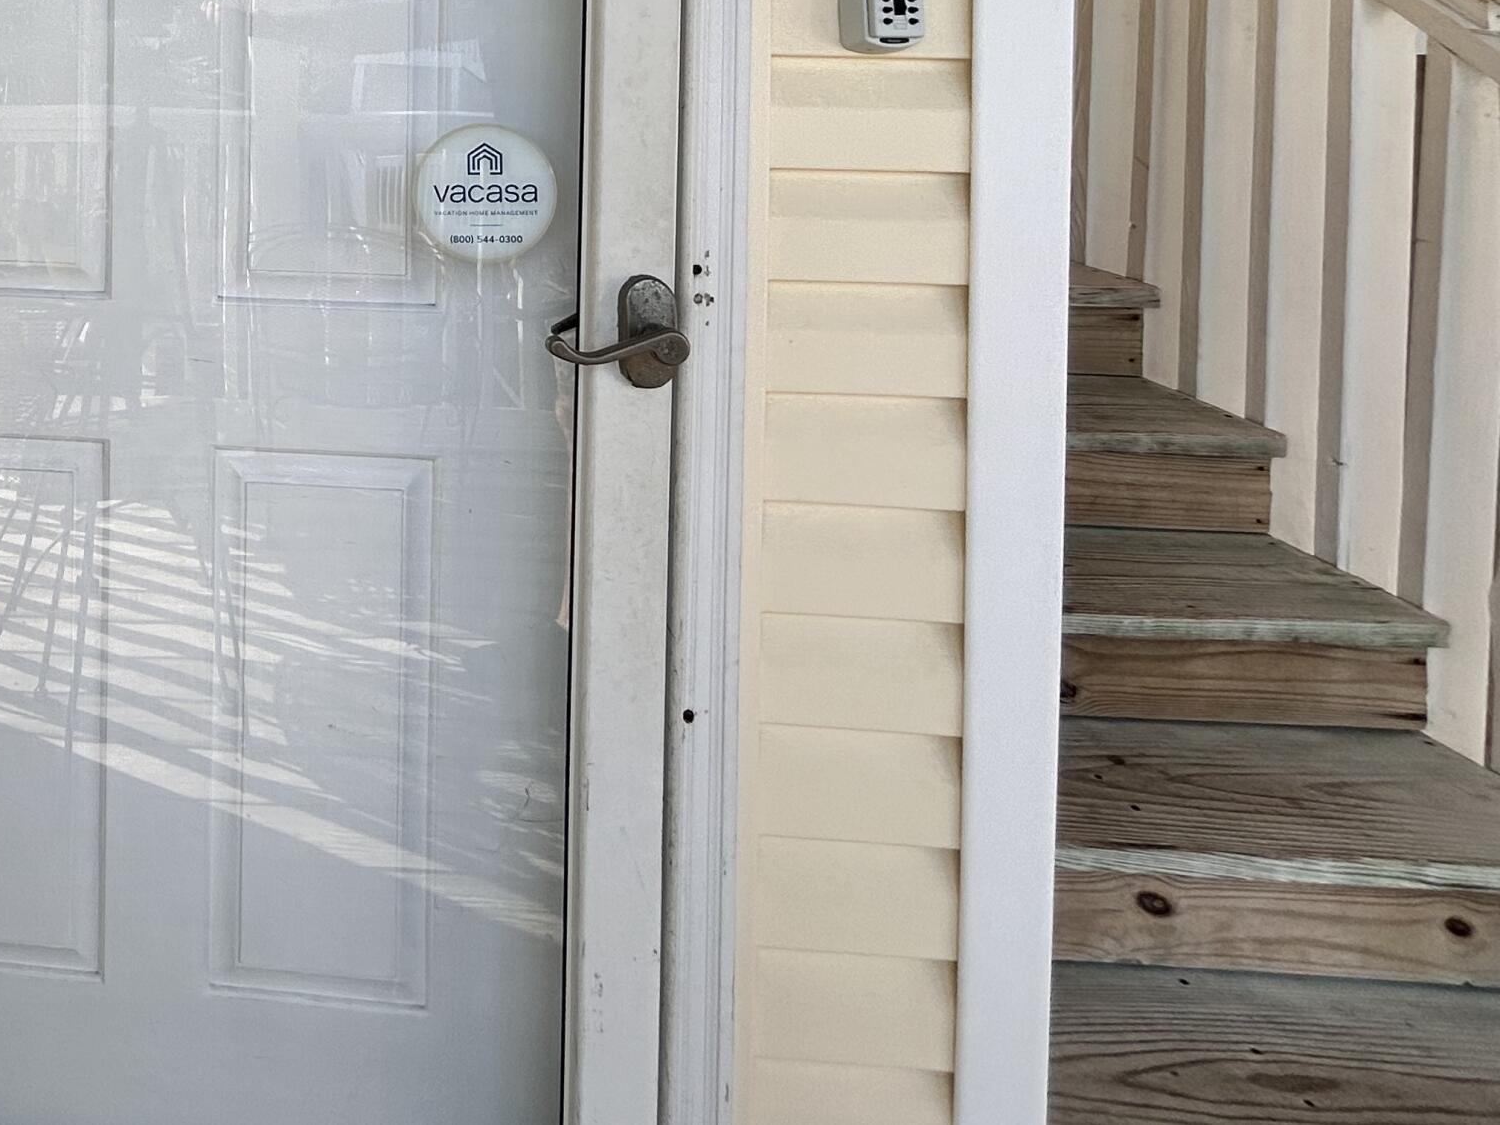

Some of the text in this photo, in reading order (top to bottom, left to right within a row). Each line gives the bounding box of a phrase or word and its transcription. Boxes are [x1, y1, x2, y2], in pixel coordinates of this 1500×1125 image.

[433, 183, 538, 204] vacasa
[450, 235, 523, 244] (800) 544-0300
